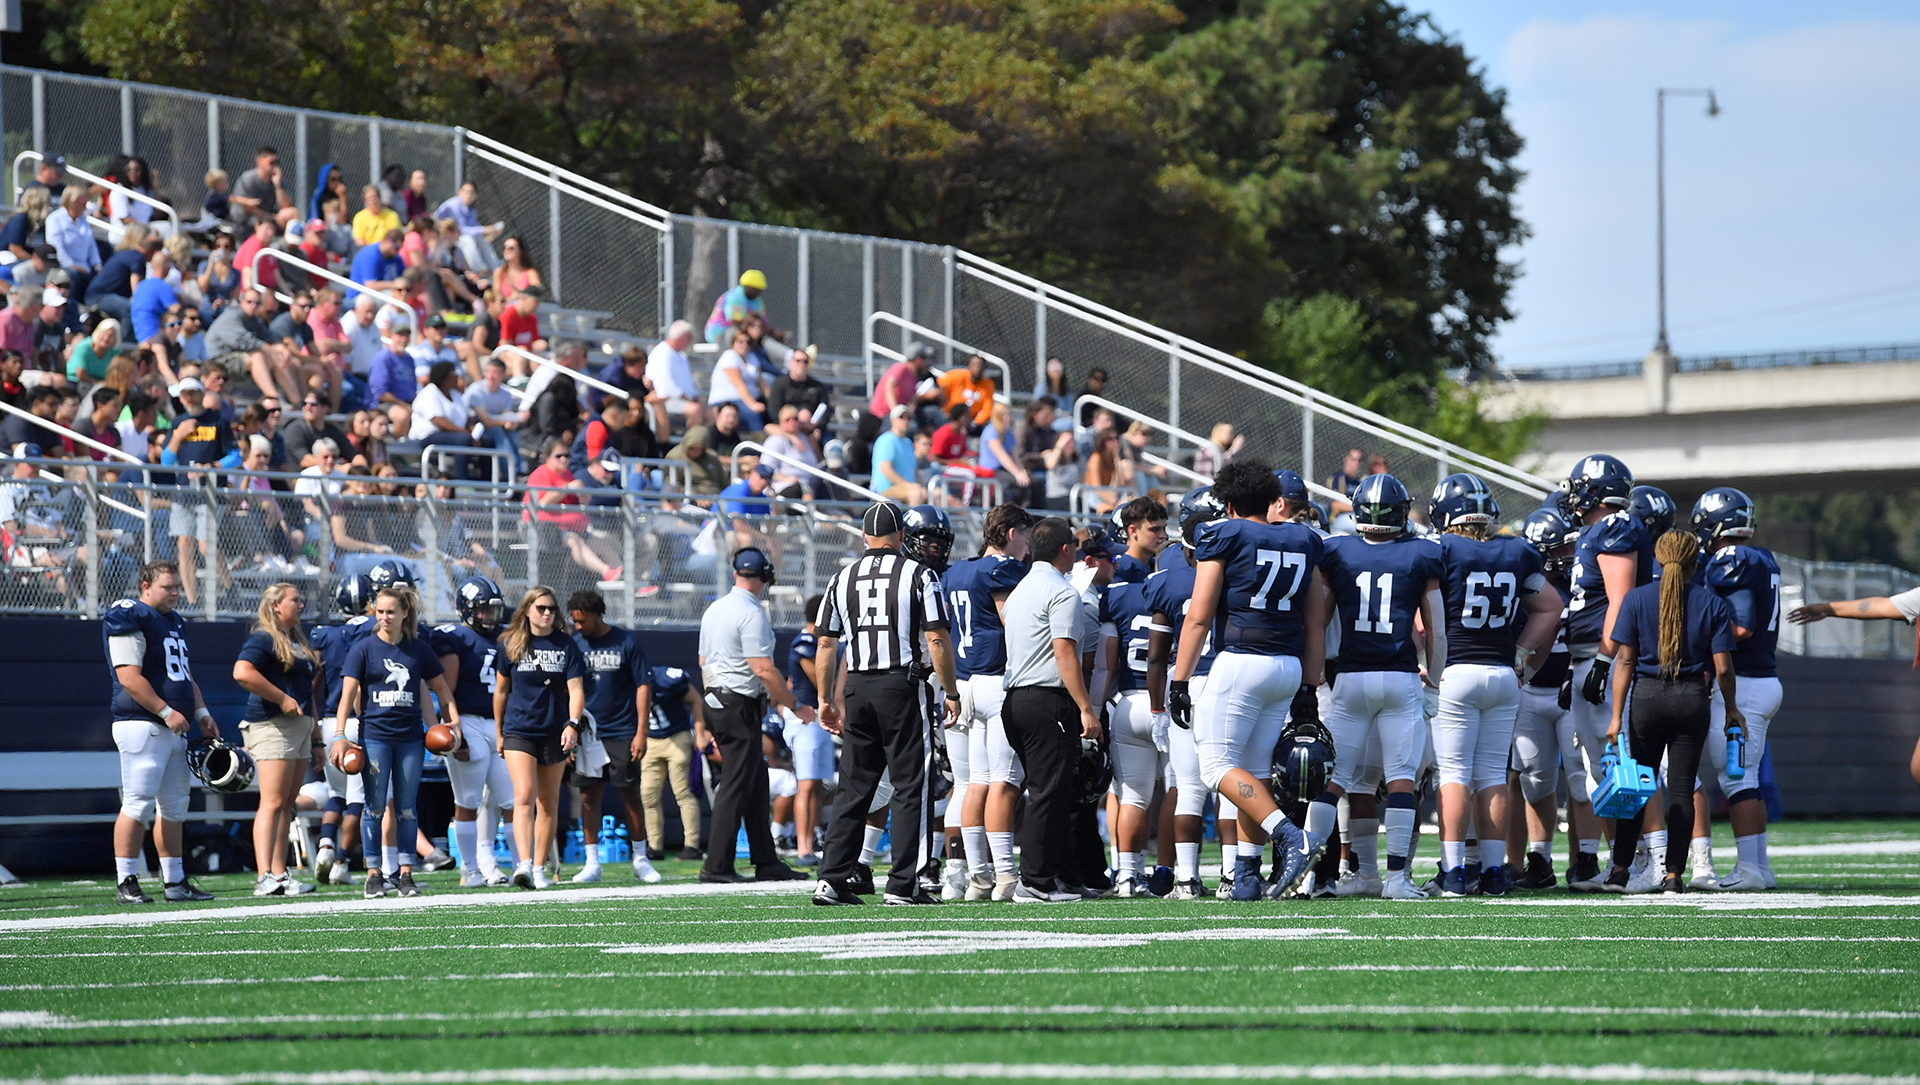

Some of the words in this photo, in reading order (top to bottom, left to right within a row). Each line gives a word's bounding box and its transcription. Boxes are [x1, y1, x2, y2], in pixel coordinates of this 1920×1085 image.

[856, 578, 890, 627] H
[1250, 549, 1306, 611] 77
[1354, 571, 1393, 634] 11
[1461, 571, 1516, 629] 63
[163, 637, 191, 682] 66
